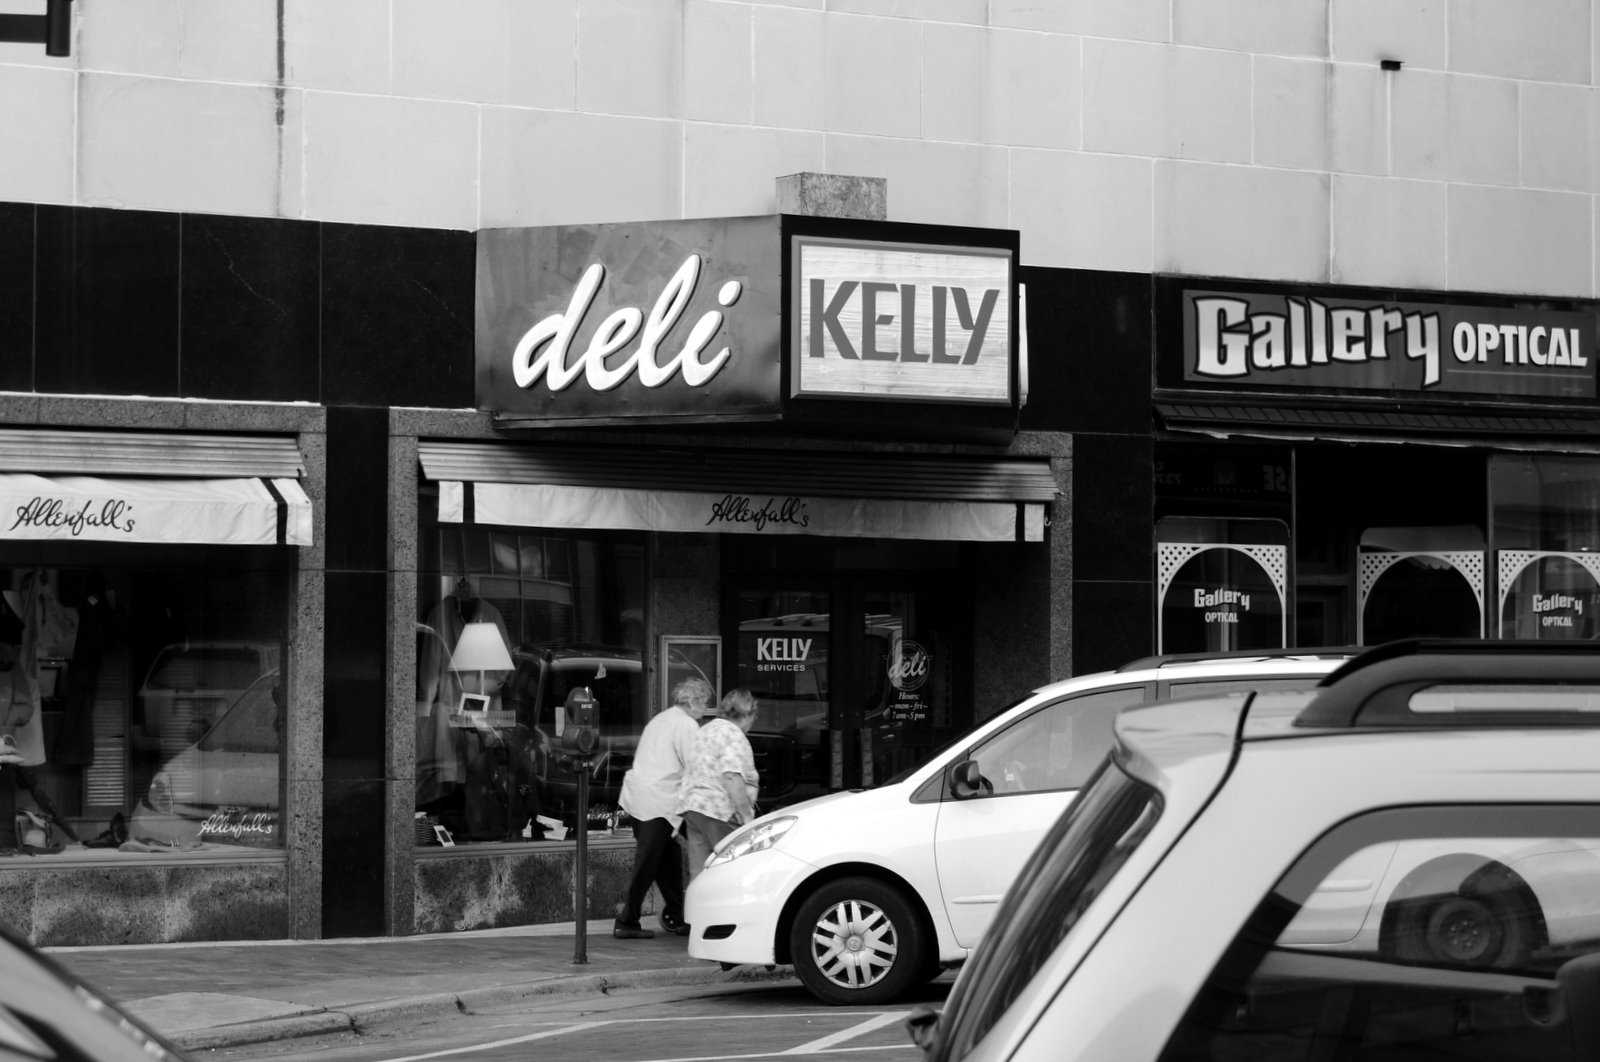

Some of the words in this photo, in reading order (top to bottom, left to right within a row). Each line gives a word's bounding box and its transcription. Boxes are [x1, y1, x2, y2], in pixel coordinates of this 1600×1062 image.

[512, 254, 742, 391] deli
[808, 278, 1000, 366] KELLY
[1193, 297, 1440, 387] Gallery
[1452, 321, 1588, 367] OPTICAL
[1193, 587, 1251, 611] Gallery
[1532, 592, 1583, 616] Gallery
[1204, 611, 1239, 623] OPTICAL
[1542, 615, 1573, 627] OPTICAL
[757, 637, 812, 661] KELLY
[757, 664, 806, 672] SERVICES
[888, 651, 927, 679] deli
